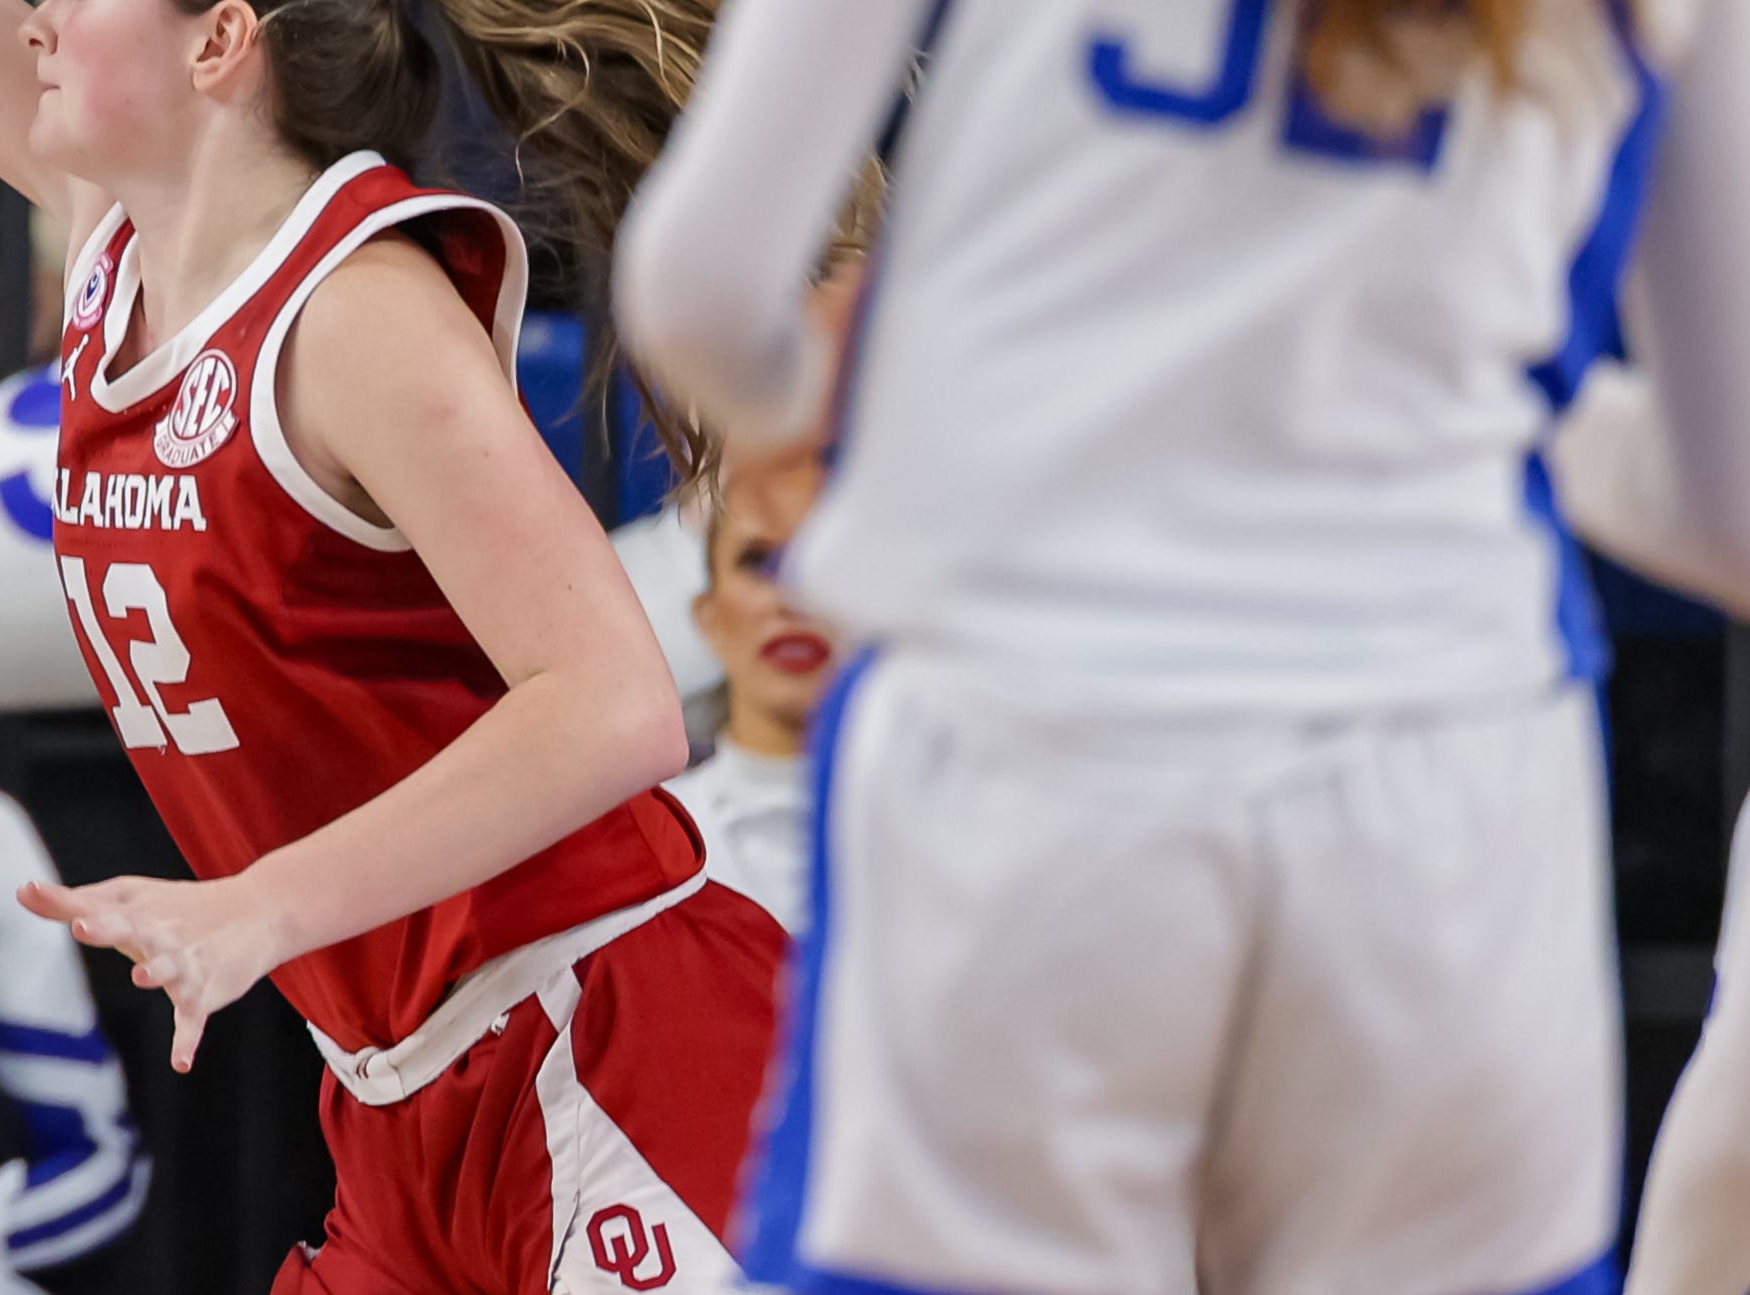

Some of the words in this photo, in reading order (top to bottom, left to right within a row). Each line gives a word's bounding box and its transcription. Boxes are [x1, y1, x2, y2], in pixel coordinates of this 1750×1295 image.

[172, 356, 232, 439] SEC
[52, 468, 207, 532] LAHOMA
[60, 555, 240, 755] 12
[586, 1203, 677, 1292] OU
